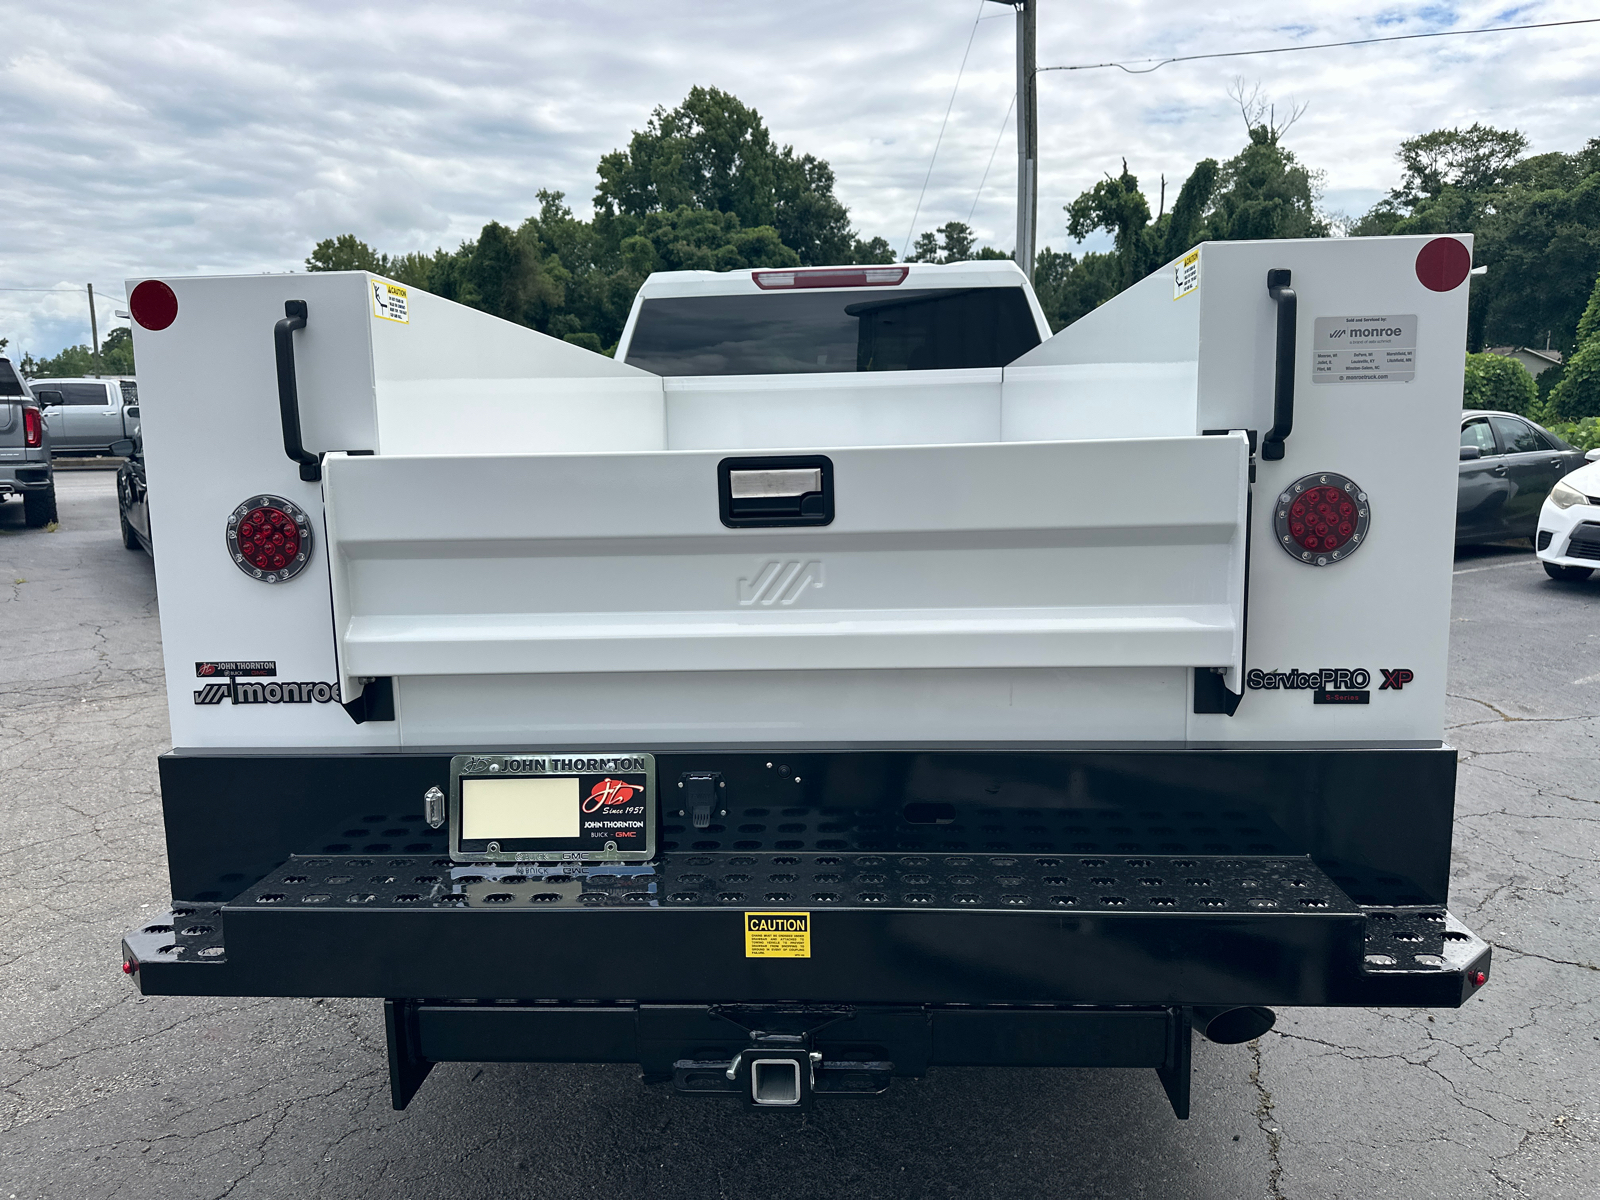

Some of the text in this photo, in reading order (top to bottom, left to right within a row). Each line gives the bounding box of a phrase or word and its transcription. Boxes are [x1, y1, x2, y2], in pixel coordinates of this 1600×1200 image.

[1349, 327, 1402, 338] monroe
[1247, 668, 1414, 690] ServicePRO XP
[501, 758, 646, 773] JOHN THORNTON
[625, 806, 644, 814] 1957
[584, 821, 602, 829] JOHN
[750, 919, 805, 931] CAUTION
